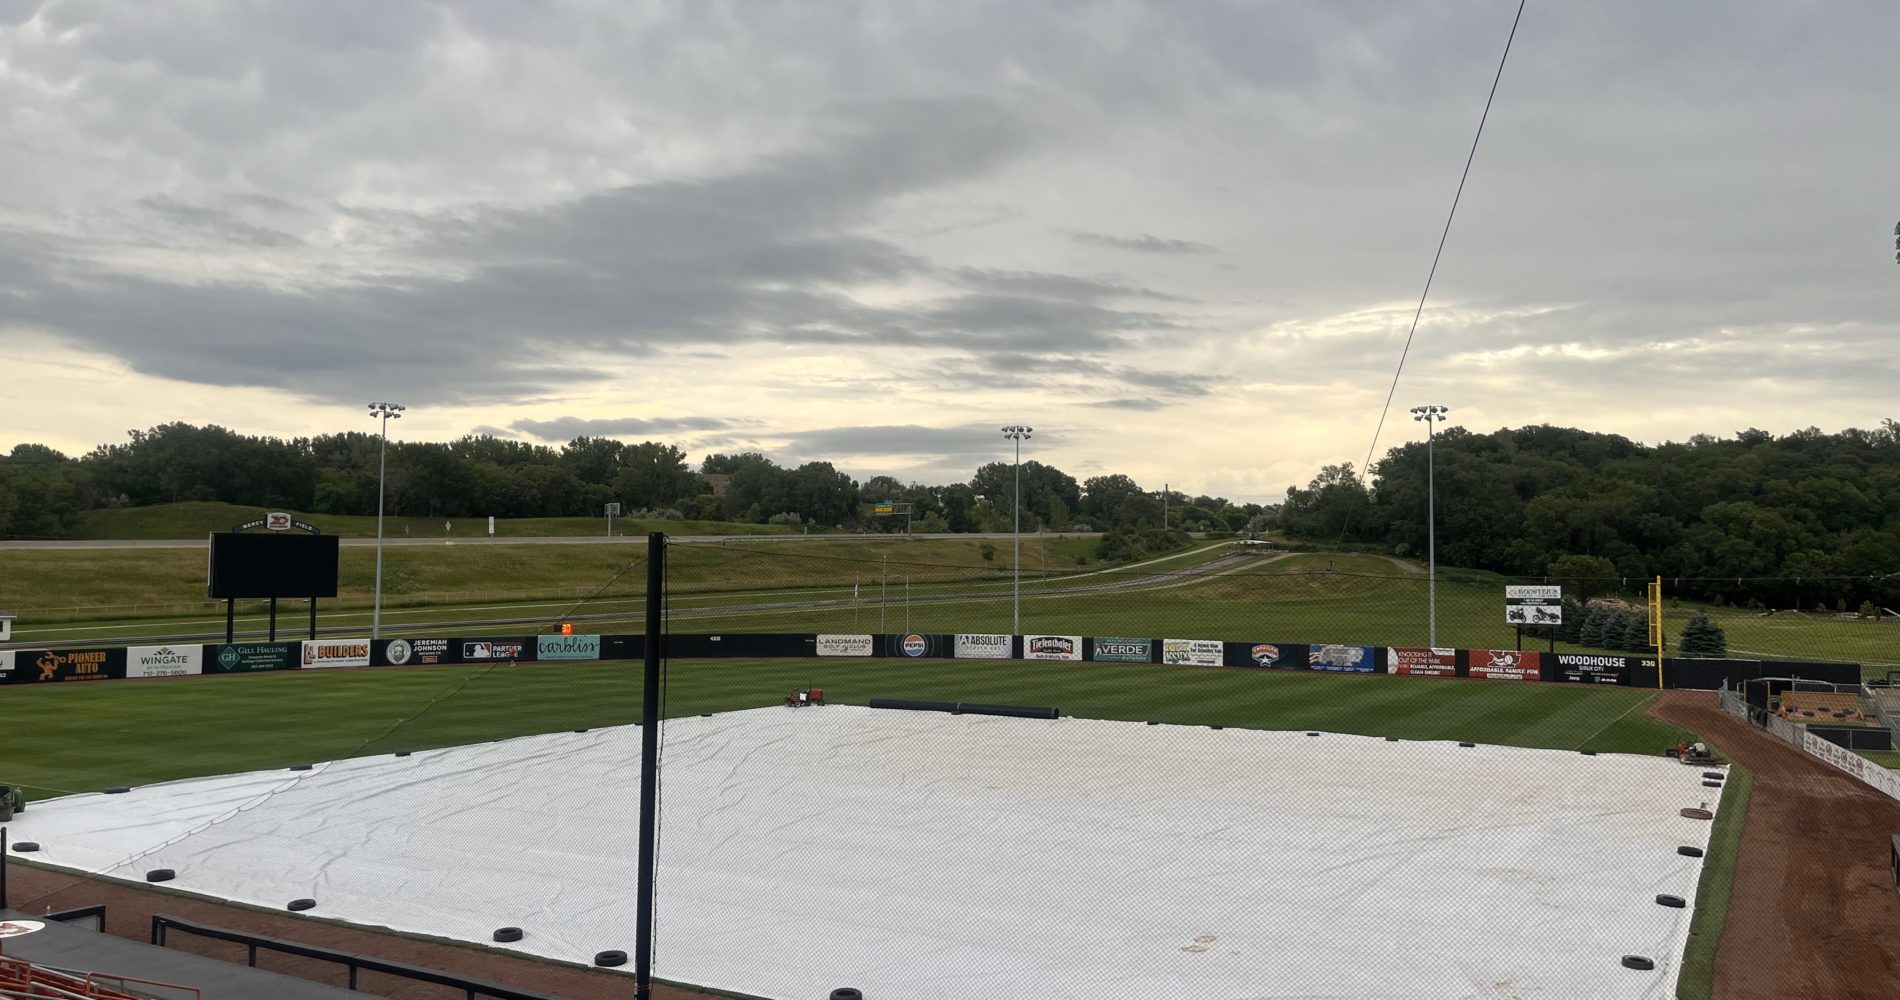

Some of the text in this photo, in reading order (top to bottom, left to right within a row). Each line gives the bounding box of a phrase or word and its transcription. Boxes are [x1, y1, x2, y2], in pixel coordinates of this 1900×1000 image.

[242, 520, 264, 529] MERCY
[295, 521, 313, 531] FIELD
[562, 623, 572, 633] 30
[539, 636, 600, 654] carbliss
[970, 635, 1007, 646] ABSOLUTE
[237, 646, 288, 655] GILL HAULING
[318, 644, 368, 659] BUILDERS
[1101, 645, 1143, 654] VERDE
[67, 652, 106, 663] PIONEER
[140, 655, 188, 665] WINGATE
[221, 653, 236, 662] GH
[1558, 655, 1625, 667] WOODHOUSE
[75, 662, 99, 674] AUTO
